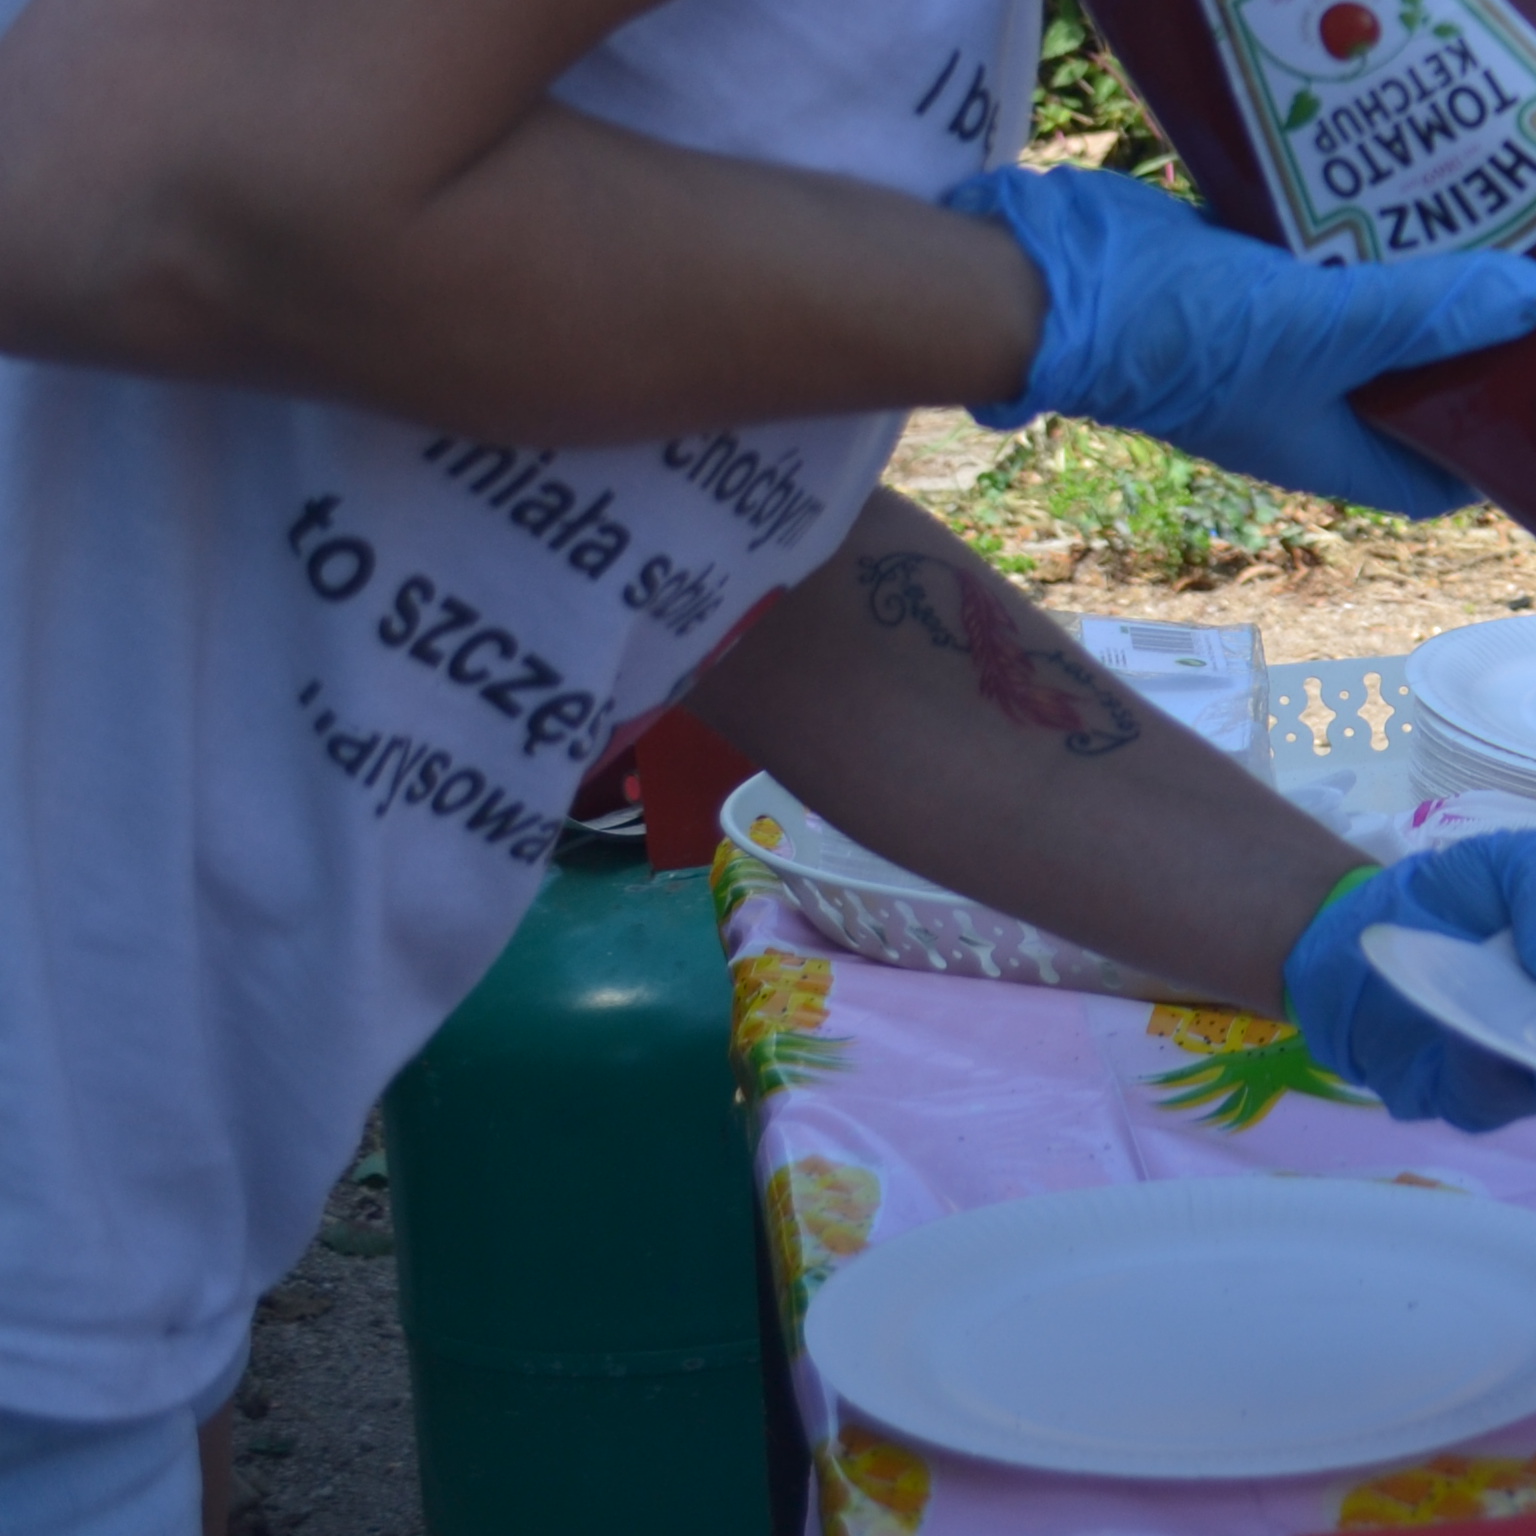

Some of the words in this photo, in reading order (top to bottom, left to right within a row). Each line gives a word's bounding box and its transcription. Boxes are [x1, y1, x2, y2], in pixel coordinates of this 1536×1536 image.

[1314, 38, 1479, 159] KETCHUP
[1323, 69, 1520, 200] TOMATO
[288, 494, 376, 602] to
